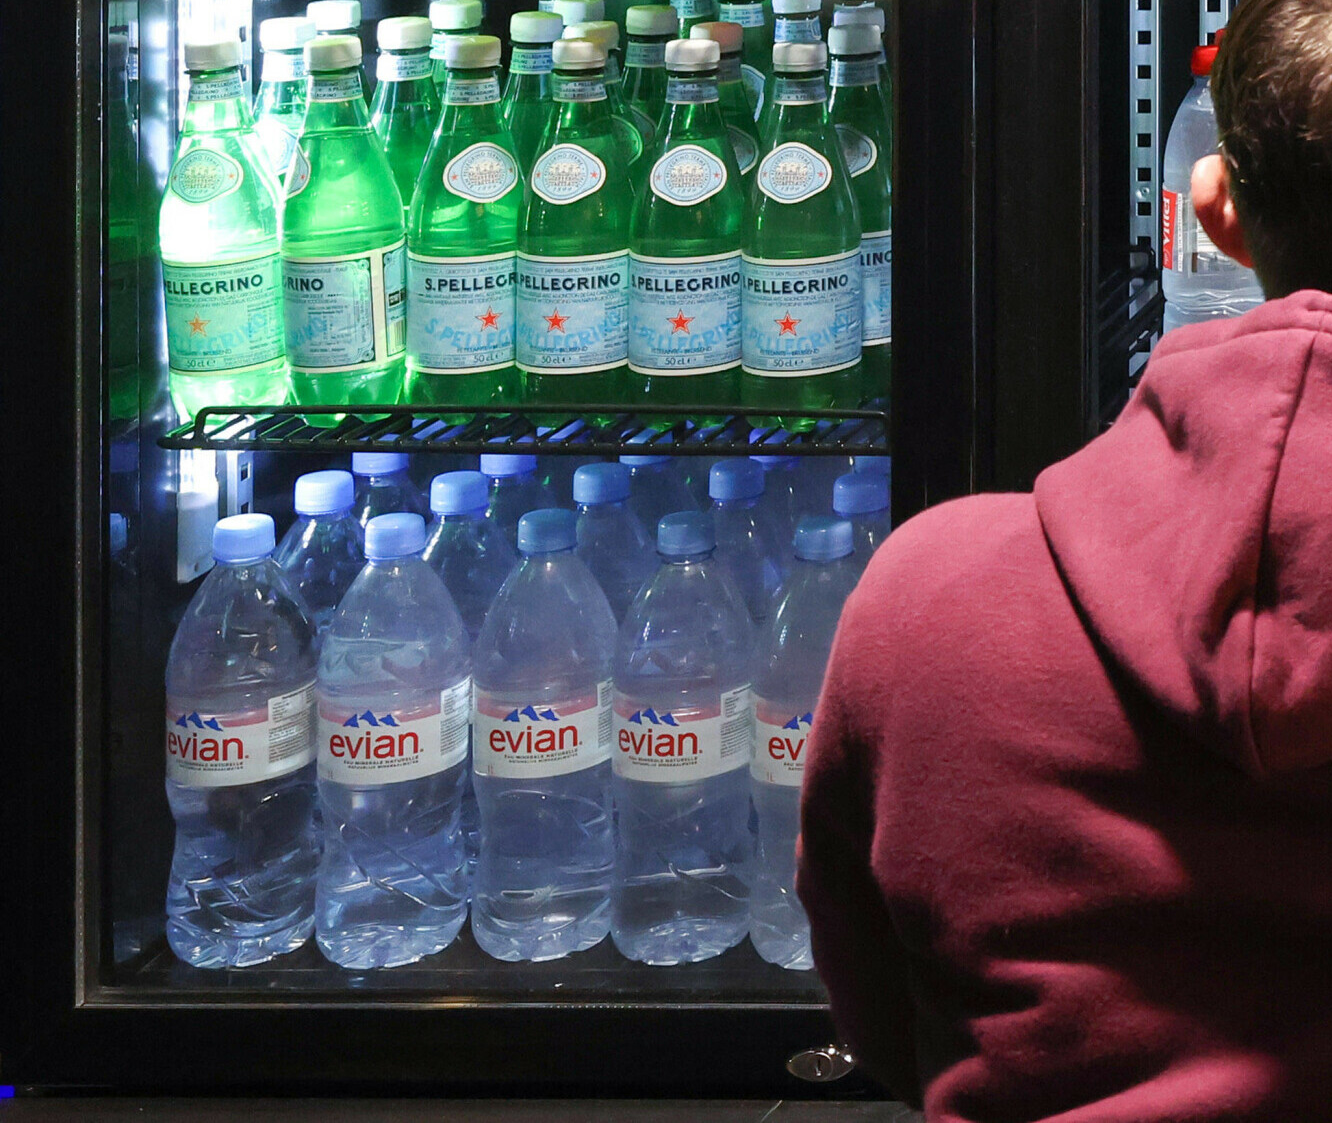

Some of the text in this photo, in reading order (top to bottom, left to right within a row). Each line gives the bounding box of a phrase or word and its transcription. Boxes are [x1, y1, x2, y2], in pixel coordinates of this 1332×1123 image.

[474, 355, 486, 364] 50
[664, 357, 676, 365] 50
[773, 359, 783, 368] 50
[168, 731, 244, 762] evian
[330, 730, 420, 760] evian
[489, 725, 578, 753] evian
[618, 728, 699, 757] evian
